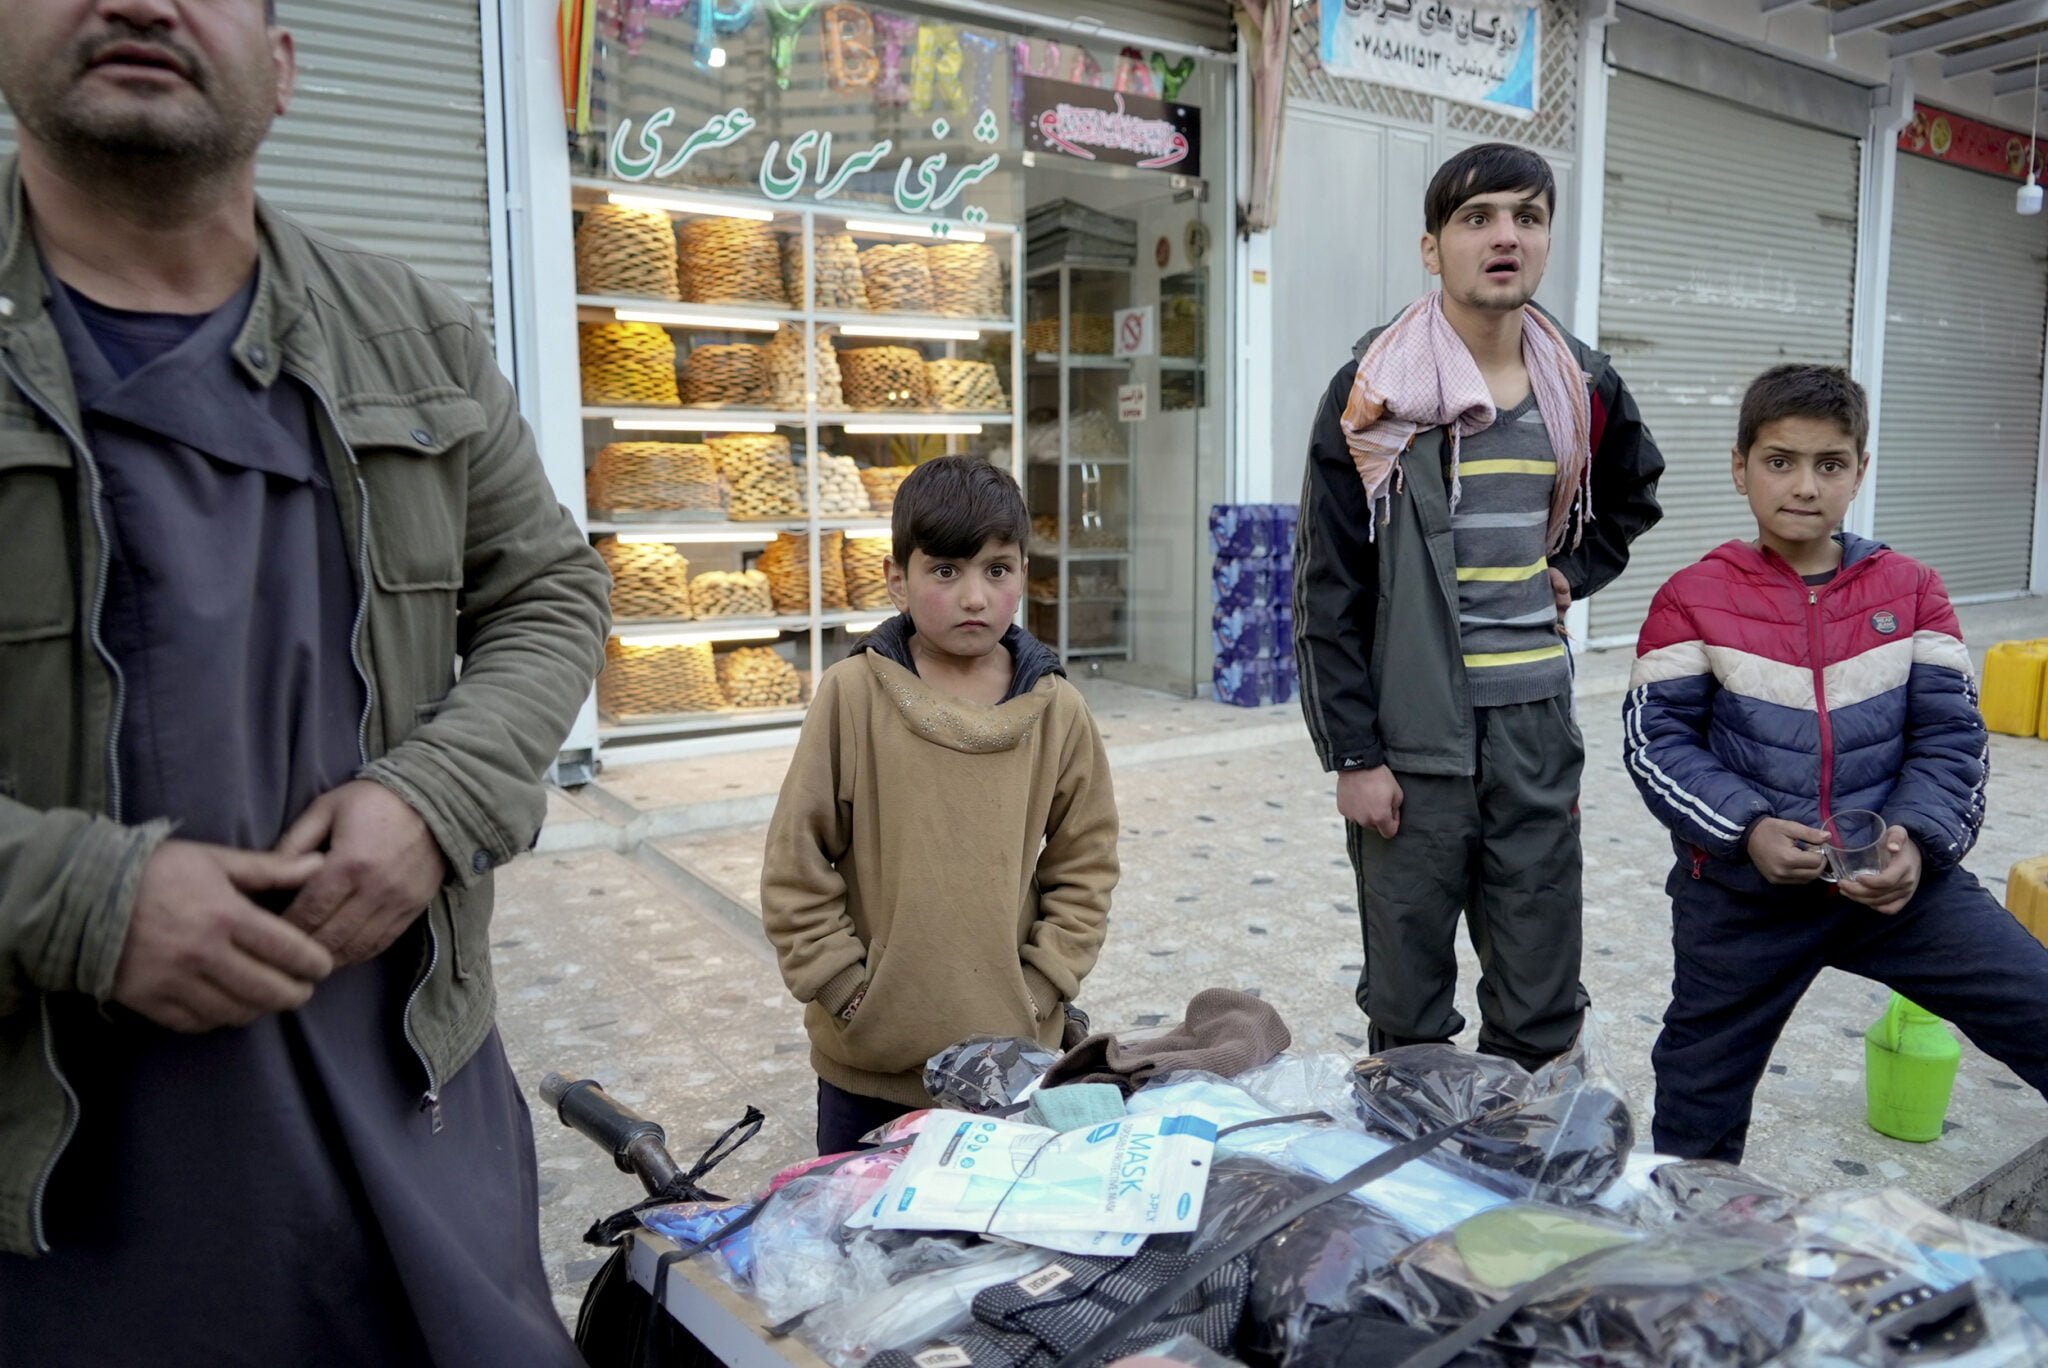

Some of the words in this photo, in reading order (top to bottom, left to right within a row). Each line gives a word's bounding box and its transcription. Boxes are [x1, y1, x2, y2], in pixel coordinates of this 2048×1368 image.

[610, 106, 756, 182] عصری
[759, 129, 893, 201] سرای
[1118, 1133, 1156, 1197] MASK
